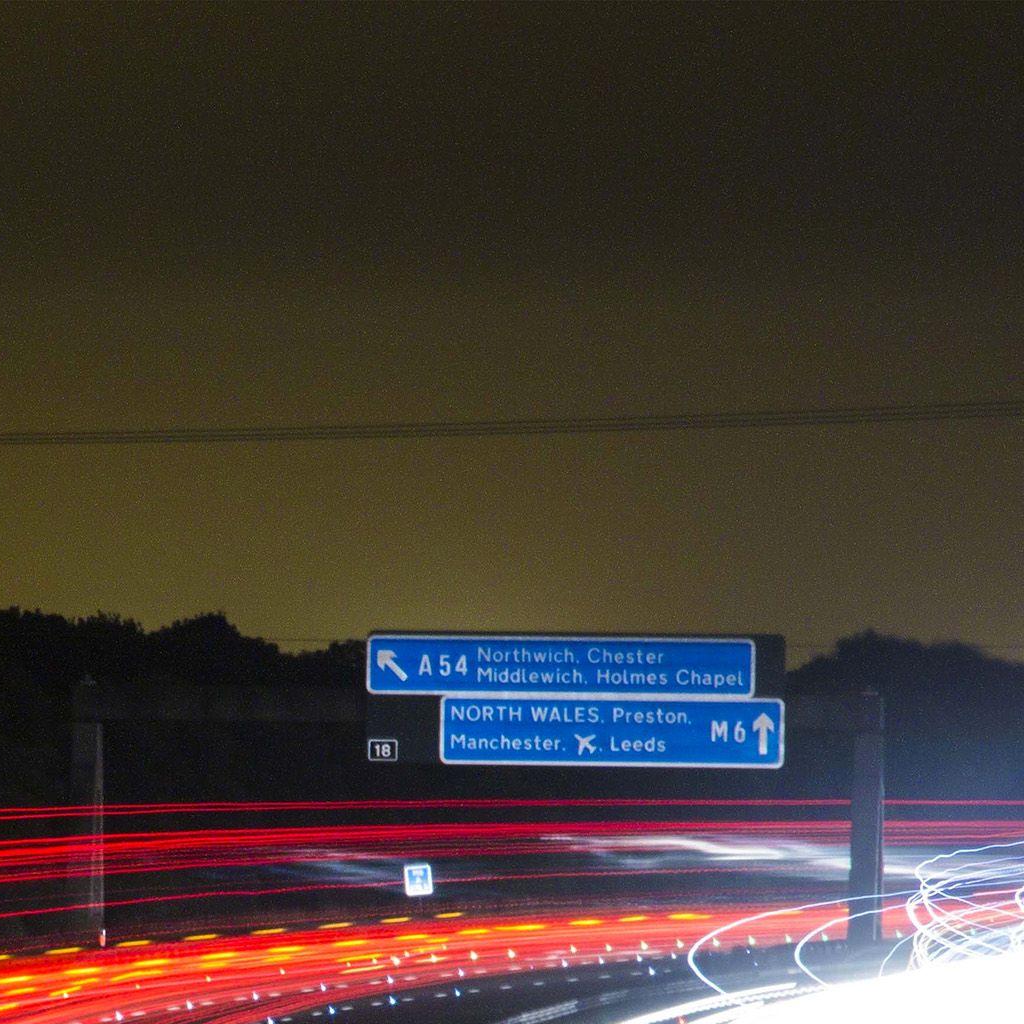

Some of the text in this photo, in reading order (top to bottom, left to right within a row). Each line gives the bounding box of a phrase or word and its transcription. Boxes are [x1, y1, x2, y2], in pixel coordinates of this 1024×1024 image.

[587, 648, 664, 664] Chester
[597, 669, 668, 685] Holmes
[676, 669, 744, 688] Chapel
[451, 705, 522, 721] NORTH
[375, 744, 391, 757] 18
[610, 736, 666, 752] Leeds
